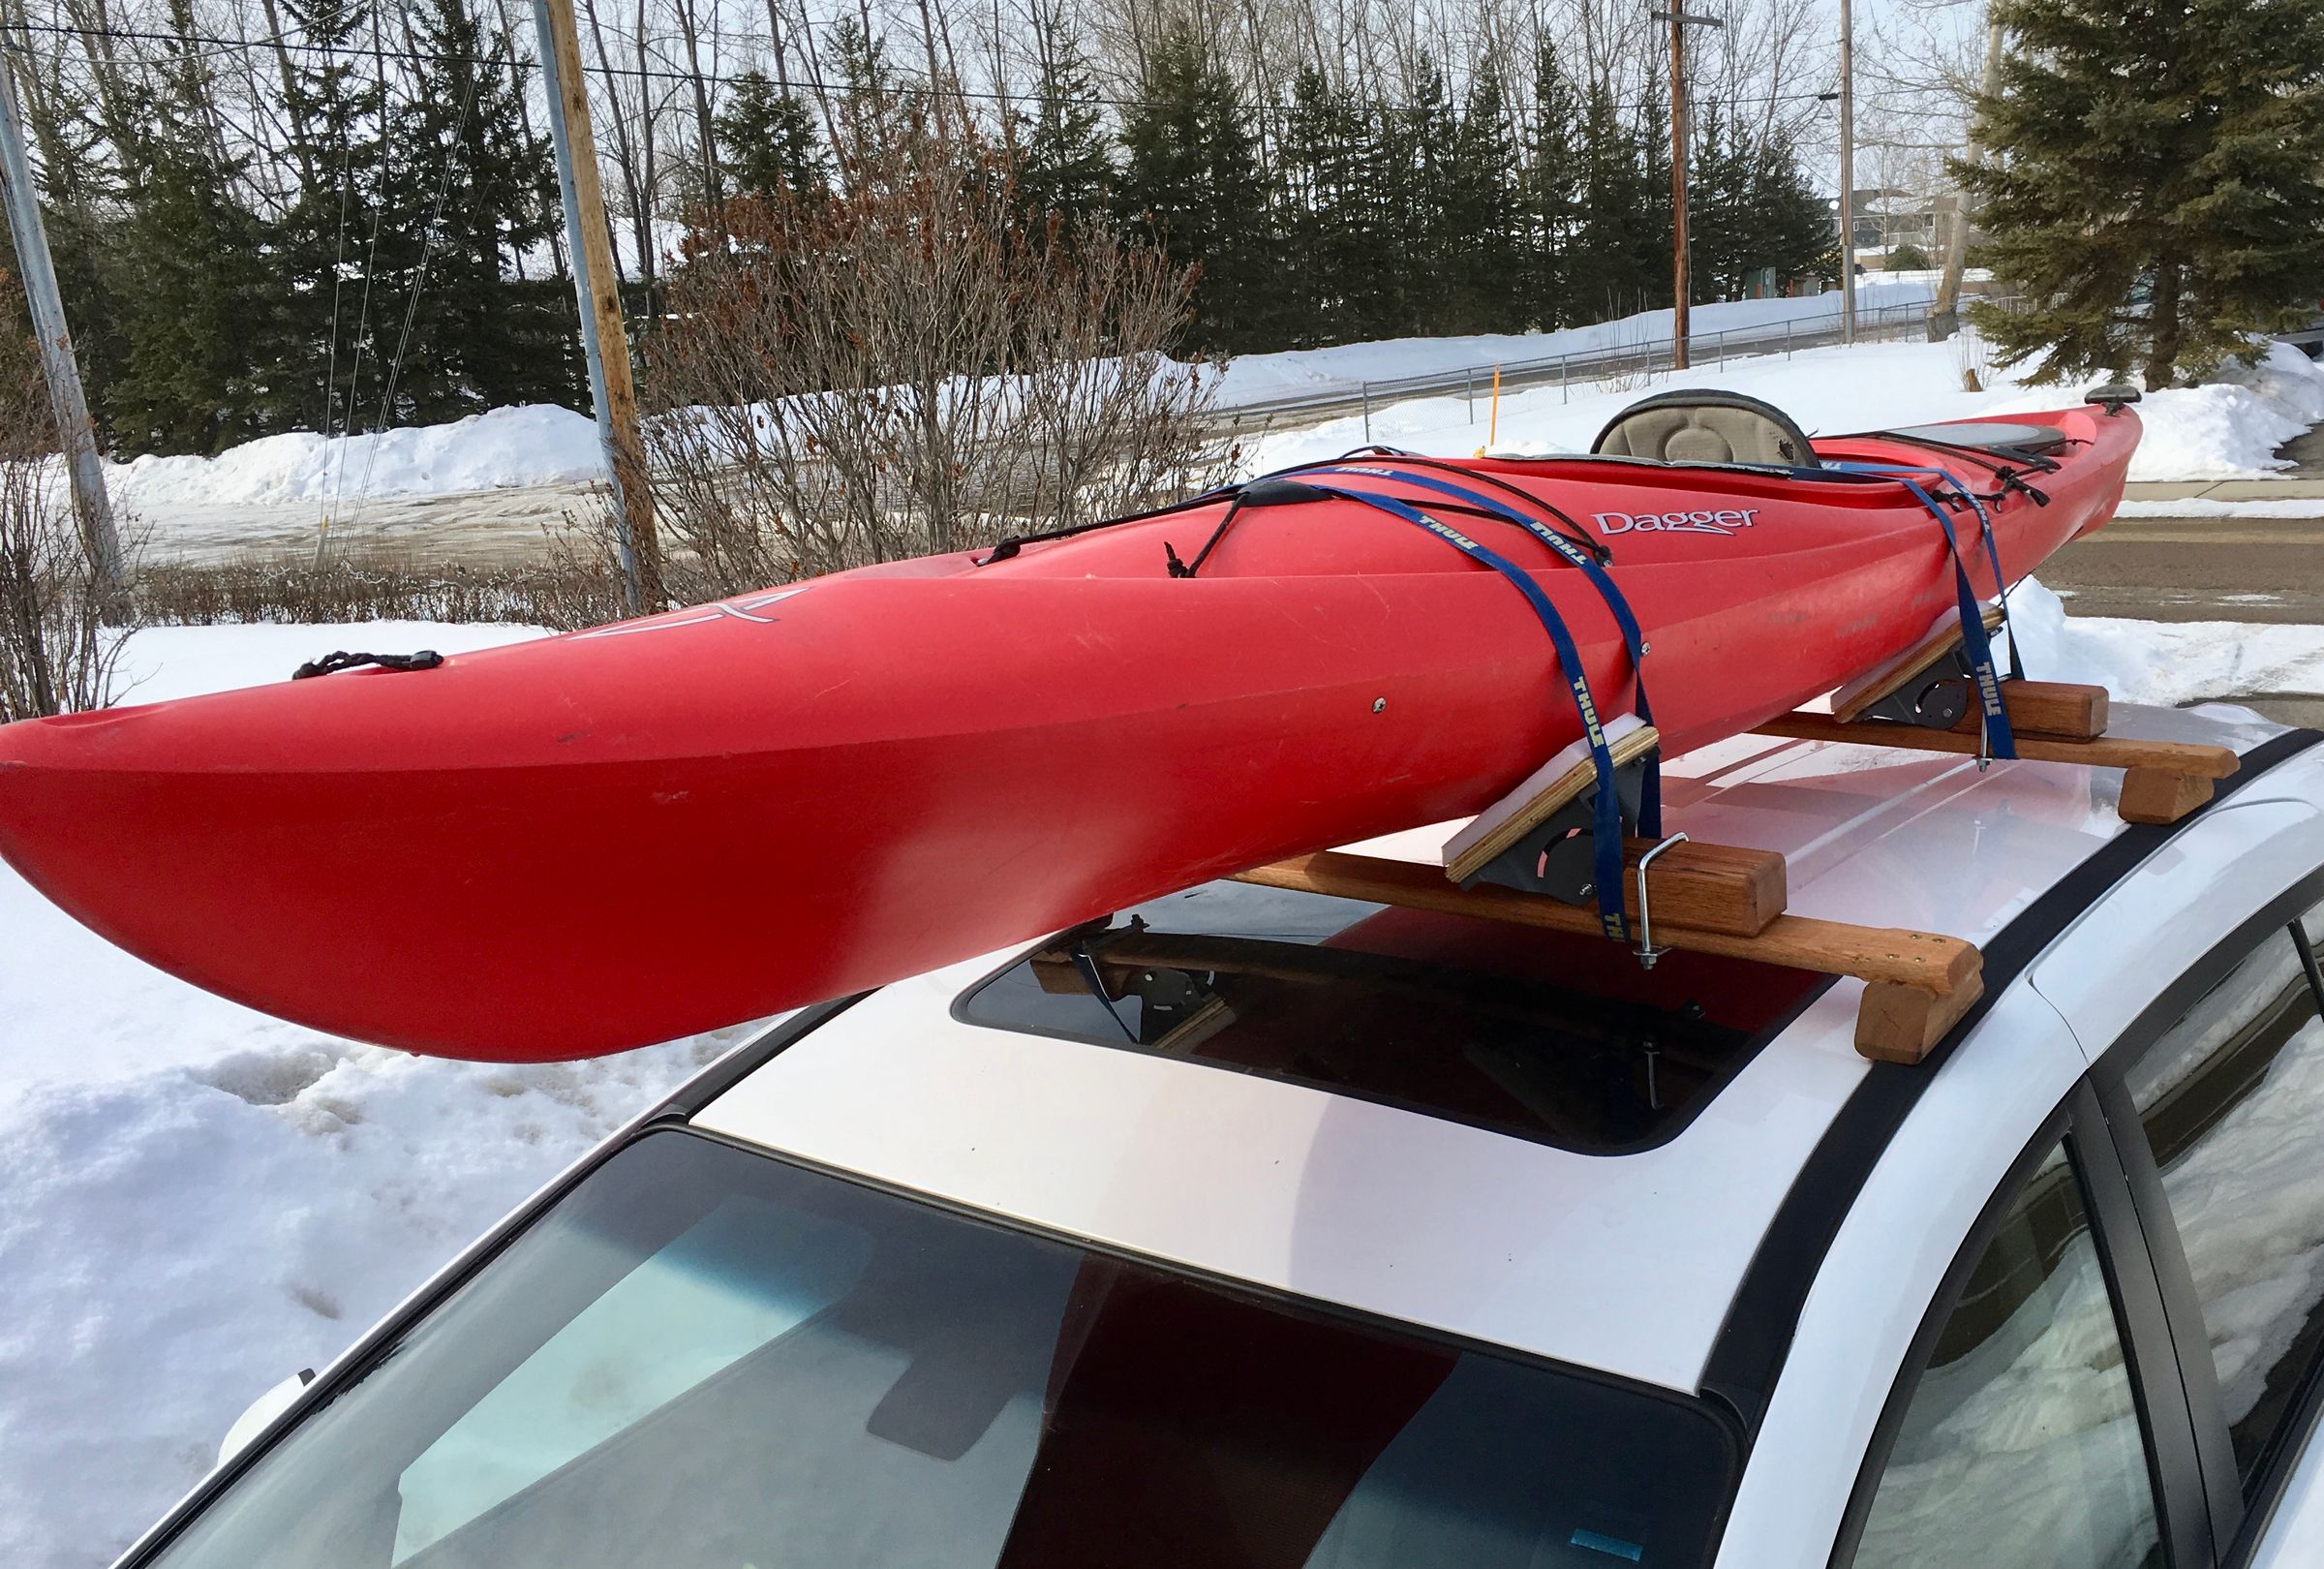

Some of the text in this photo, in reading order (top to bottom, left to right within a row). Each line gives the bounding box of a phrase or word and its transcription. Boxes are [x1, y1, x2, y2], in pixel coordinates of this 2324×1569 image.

[1420, 515, 1479, 549] THULE
[1590, 508, 1759, 536] Dagger
[1530, 521, 1587, 565] THULE
[1975, 661, 2002, 716] THULE
[1574, 675, 1605, 748] THULE
[1604, 913, 1627, 942] TH
